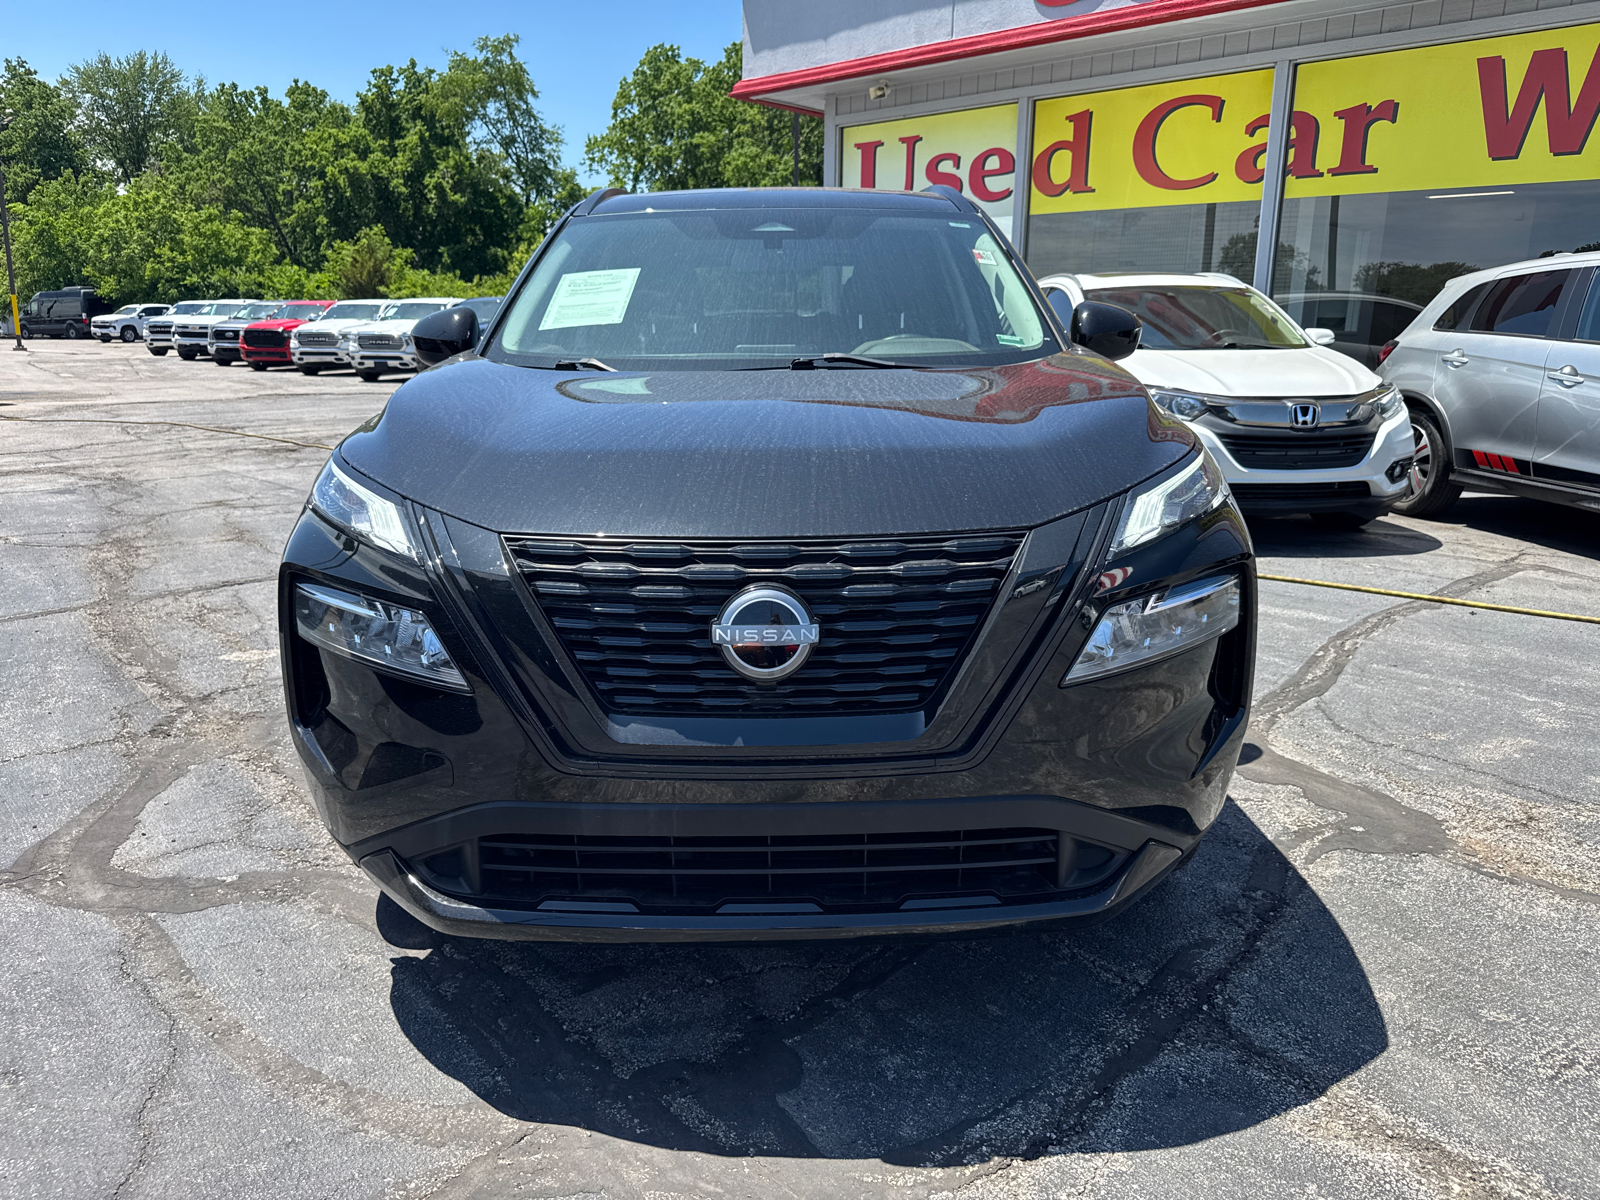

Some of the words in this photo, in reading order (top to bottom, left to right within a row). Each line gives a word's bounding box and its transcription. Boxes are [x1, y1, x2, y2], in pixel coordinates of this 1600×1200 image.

[854, 109, 1095, 202] Used
[1132, 94, 1399, 190] Car
[715, 628, 816, 642] NISSAN
